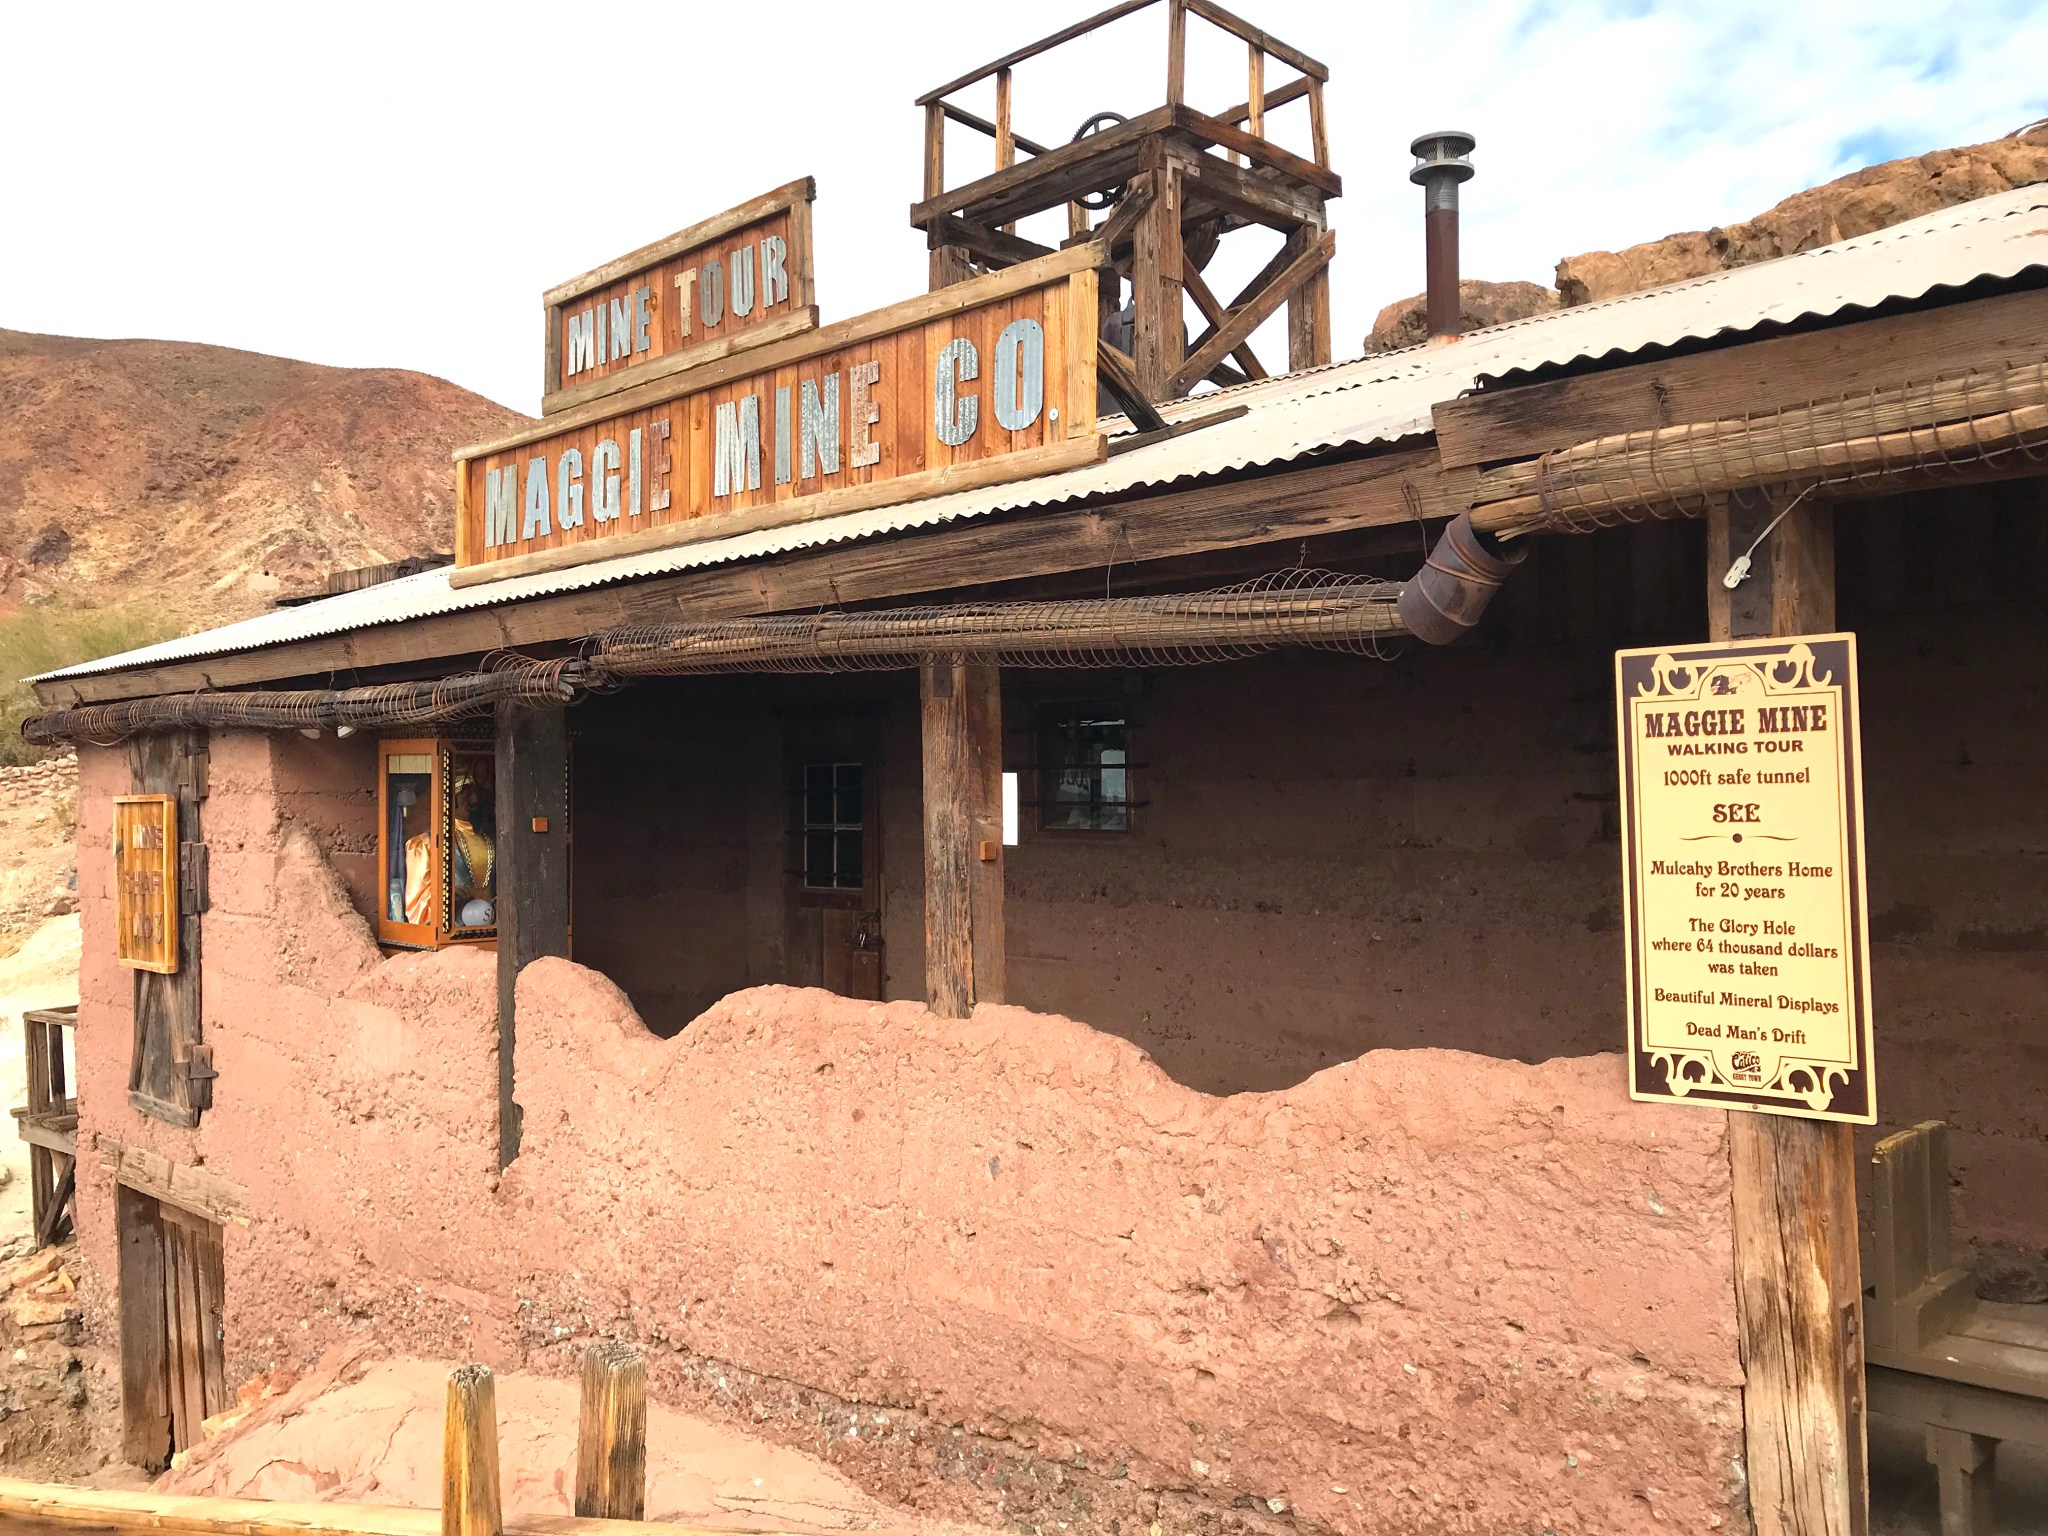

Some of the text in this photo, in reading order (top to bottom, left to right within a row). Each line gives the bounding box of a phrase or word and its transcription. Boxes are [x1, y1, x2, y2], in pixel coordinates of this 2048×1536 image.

[568, 235, 788, 376] MINE TOUR
[485, 419, 670, 548] MAGGIE
[714, 361, 880, 497] MINE
[1645, 705, 1827, 738] MAGGIE MINE
[1667, 740, 1804, 756] WALKING TOUR
[1664, 767, 1810, 786] 1000ft safe tunnel
[1713, 803, 1761, 823] SEE
[1651, 860, 1833, 878] Mulcahy Brothers Home
[1696, 882, 1785, 900] for 20 years
[1688, 918, 1796, 937] The Glory Hole
[1652, 938, 1839, 958] where 64 thousand dollars
[1708, 962, 1778, 977] was taken
[1654, 988, 1839, 1015] Beautiful Mineral Displays
[1686, 1022, 1806, 1044] Dead Man's Drift
